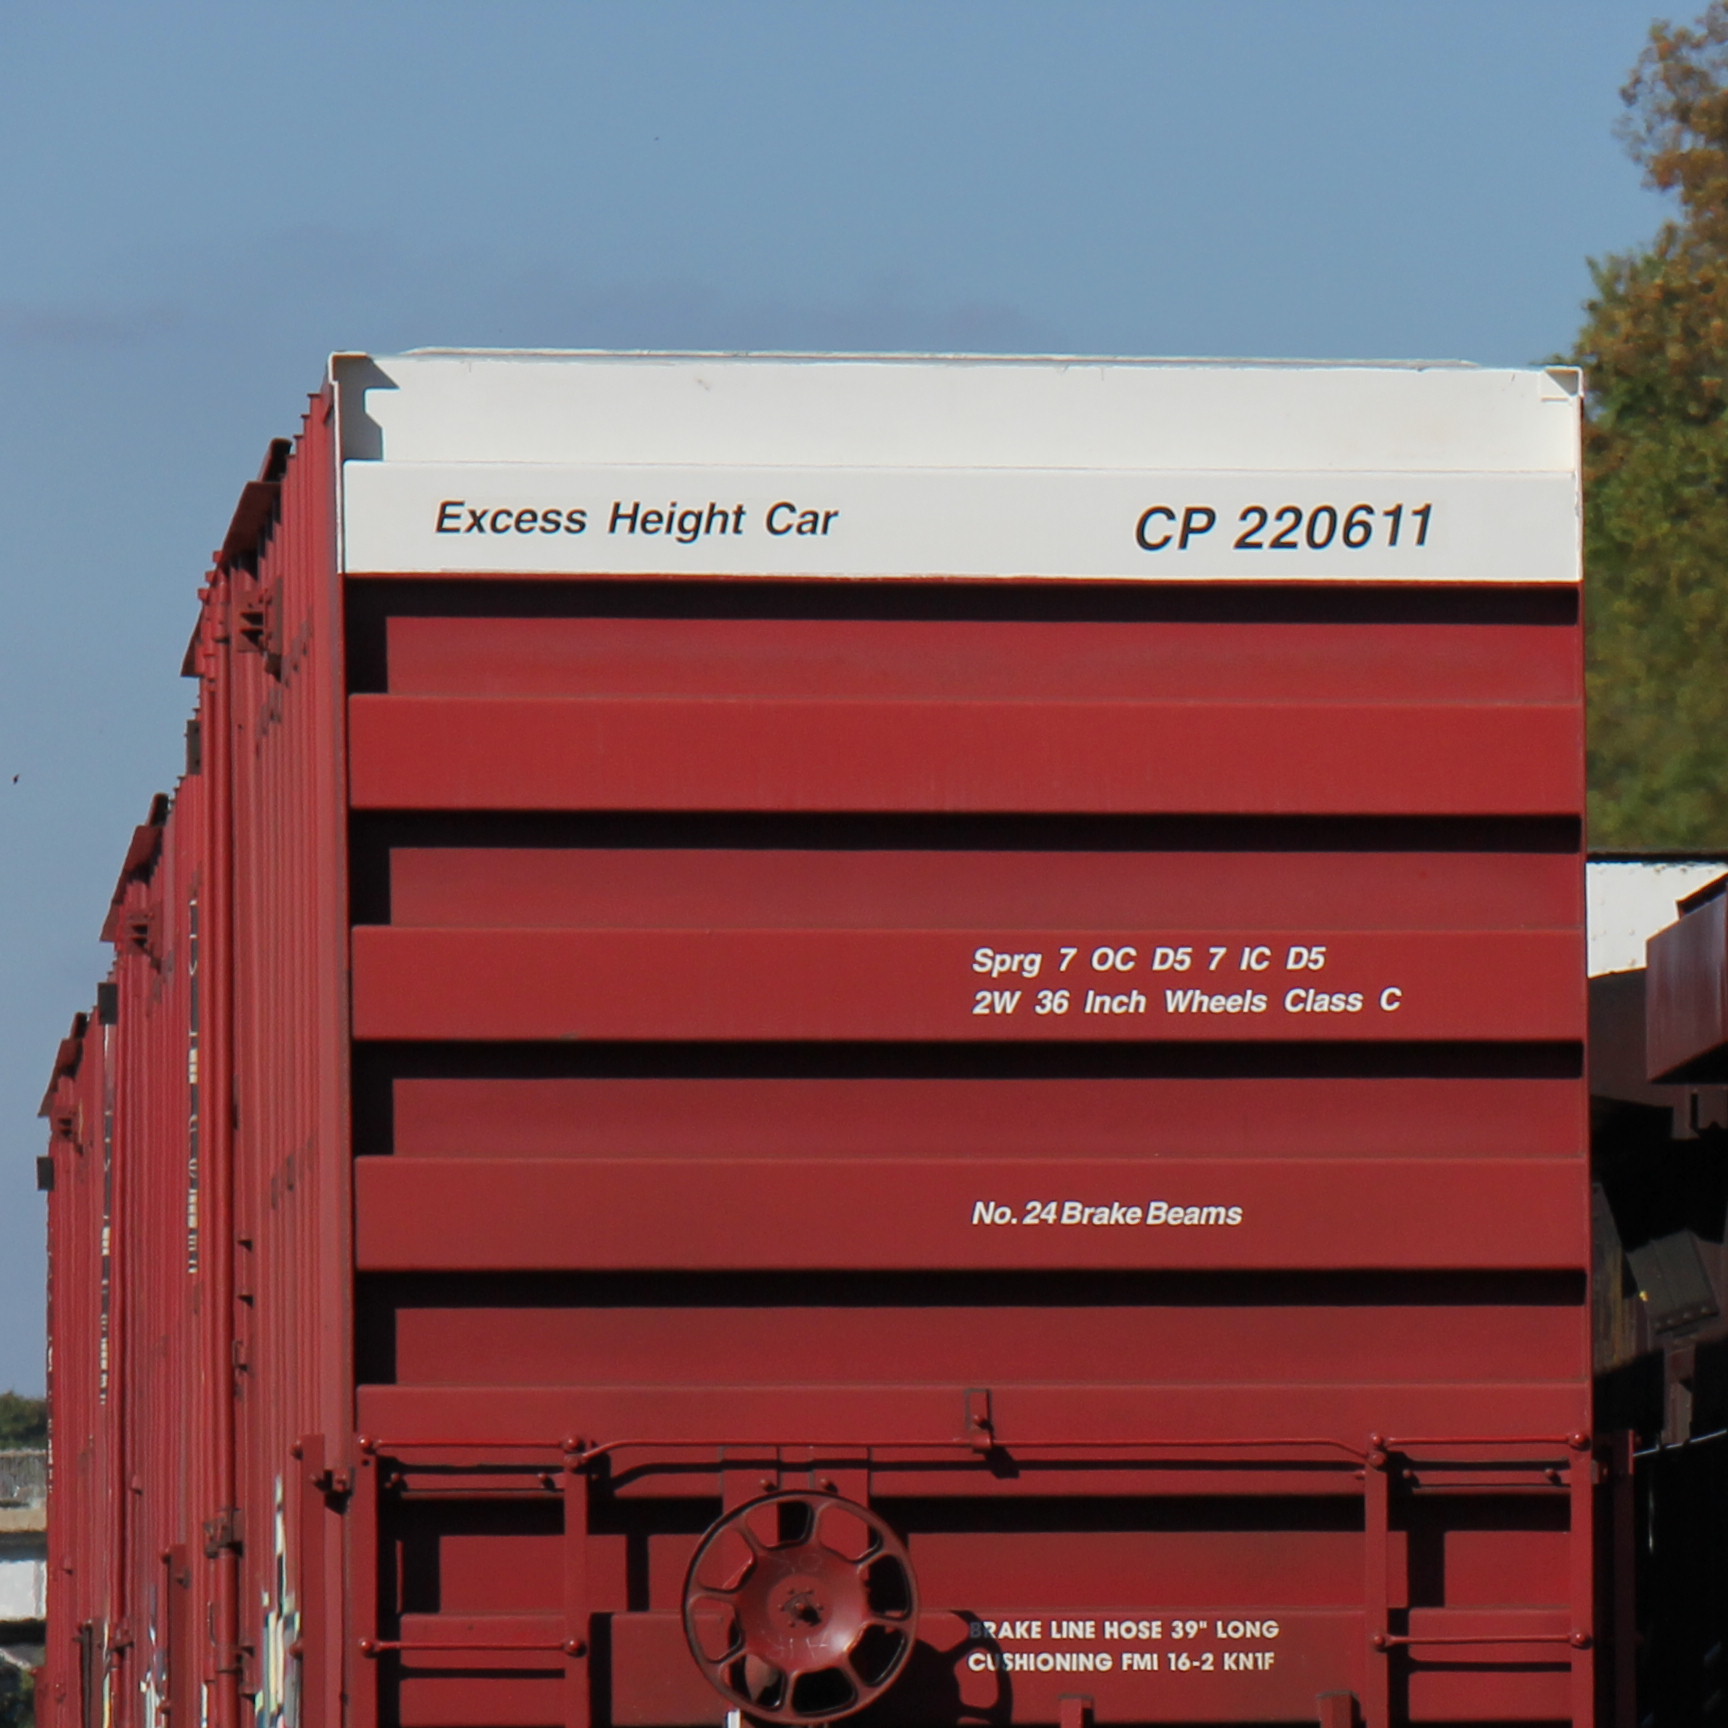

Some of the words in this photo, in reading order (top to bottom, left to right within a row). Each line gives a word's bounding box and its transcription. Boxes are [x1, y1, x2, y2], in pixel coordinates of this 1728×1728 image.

[437, 502, 586, 534] Excess
[609, 502, 745, 544] Height
[766, 502, 839, 535] Car
[1136, 507, 1216, 551] CP
[1234, 504, 1433, 549] 220611
[972, 947, 1042, 978] Sprg
[1059, 947, 1078, 972] 7
[1091, 946, 1137, 972] OC
[1152, 947, 1192, 972] D5
[1208, 946, 1227, 971] 7
[1240, 946, 1271, 971] IC
[1286, 946, 1327, 971] D5
[972, 990, 1021, 1015] 2W
[1034, 989, 1070, 1015] 36
[1084, 989, 1147, 1014] Inch
[1165, 989, 1268, 1014] Wheels
[1284, 988, 1364, 1013] Class
[1380, 987, 1402, 1012] C
[972, 1201, 1018, 1225] No.
[1022, 1201, 1058, 1225] 24
[1060, 1201, 1142, 1225] Brake
[1146, 1201, 1243, 1226] Beams
[969, 1620, 1042, 1640] BRAKE
[1050, 1620, 1096, 1639] LINE
[1104, 1620, 1163, 1640] HOSE
[1171, 1620, 1208, 1640] 39"
[1216, 1620, 1280, 1640] LONG
[967, 1652, 1113, 1672] CUSHIONING
[1121, 1652, 1159, 1671] FMI
[1167, 1652, 1215, 1672] 16-2
